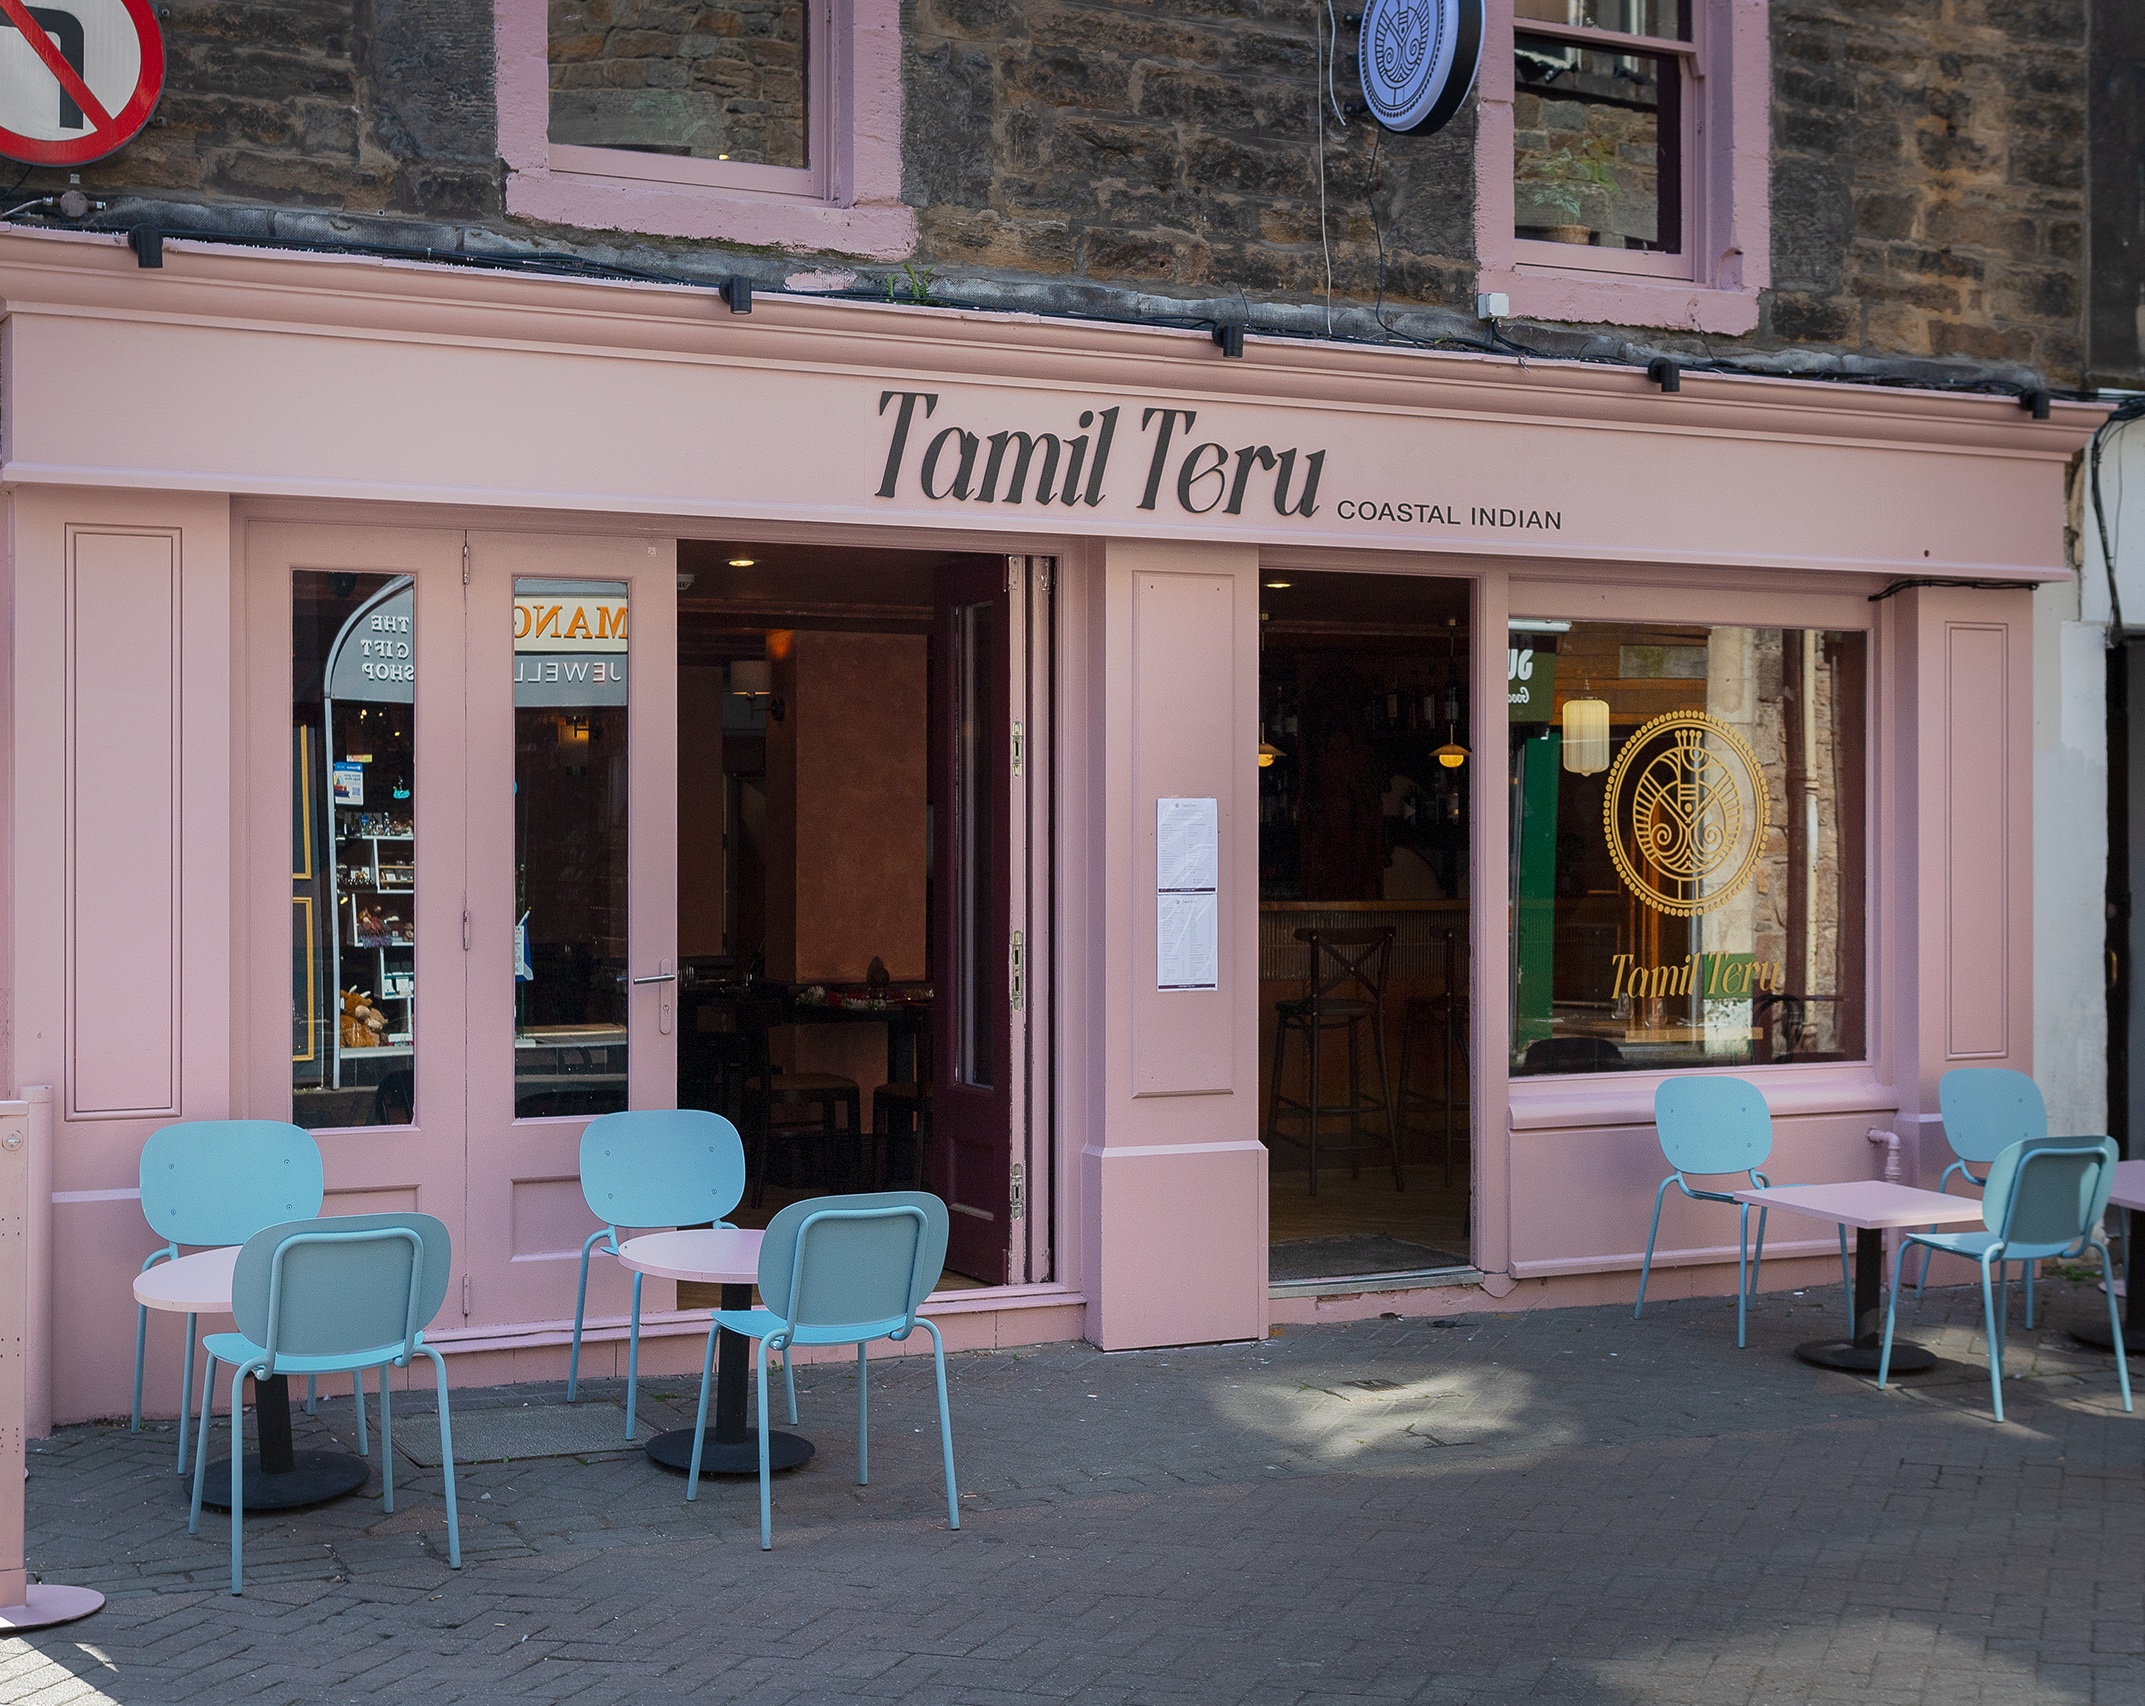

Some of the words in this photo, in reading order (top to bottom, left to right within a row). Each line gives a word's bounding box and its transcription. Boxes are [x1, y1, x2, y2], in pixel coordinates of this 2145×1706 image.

[874, 390, 1120, 507] Tamil
[1136, 407, 1326, 518] Teru
[1337, 500, 1461, 525] COASTAL
[1471, 506, 1561, 530] INDIAN
[1611, 952, 1700, 999] Tamil
[1708, 950, 1780, 995] Teru
